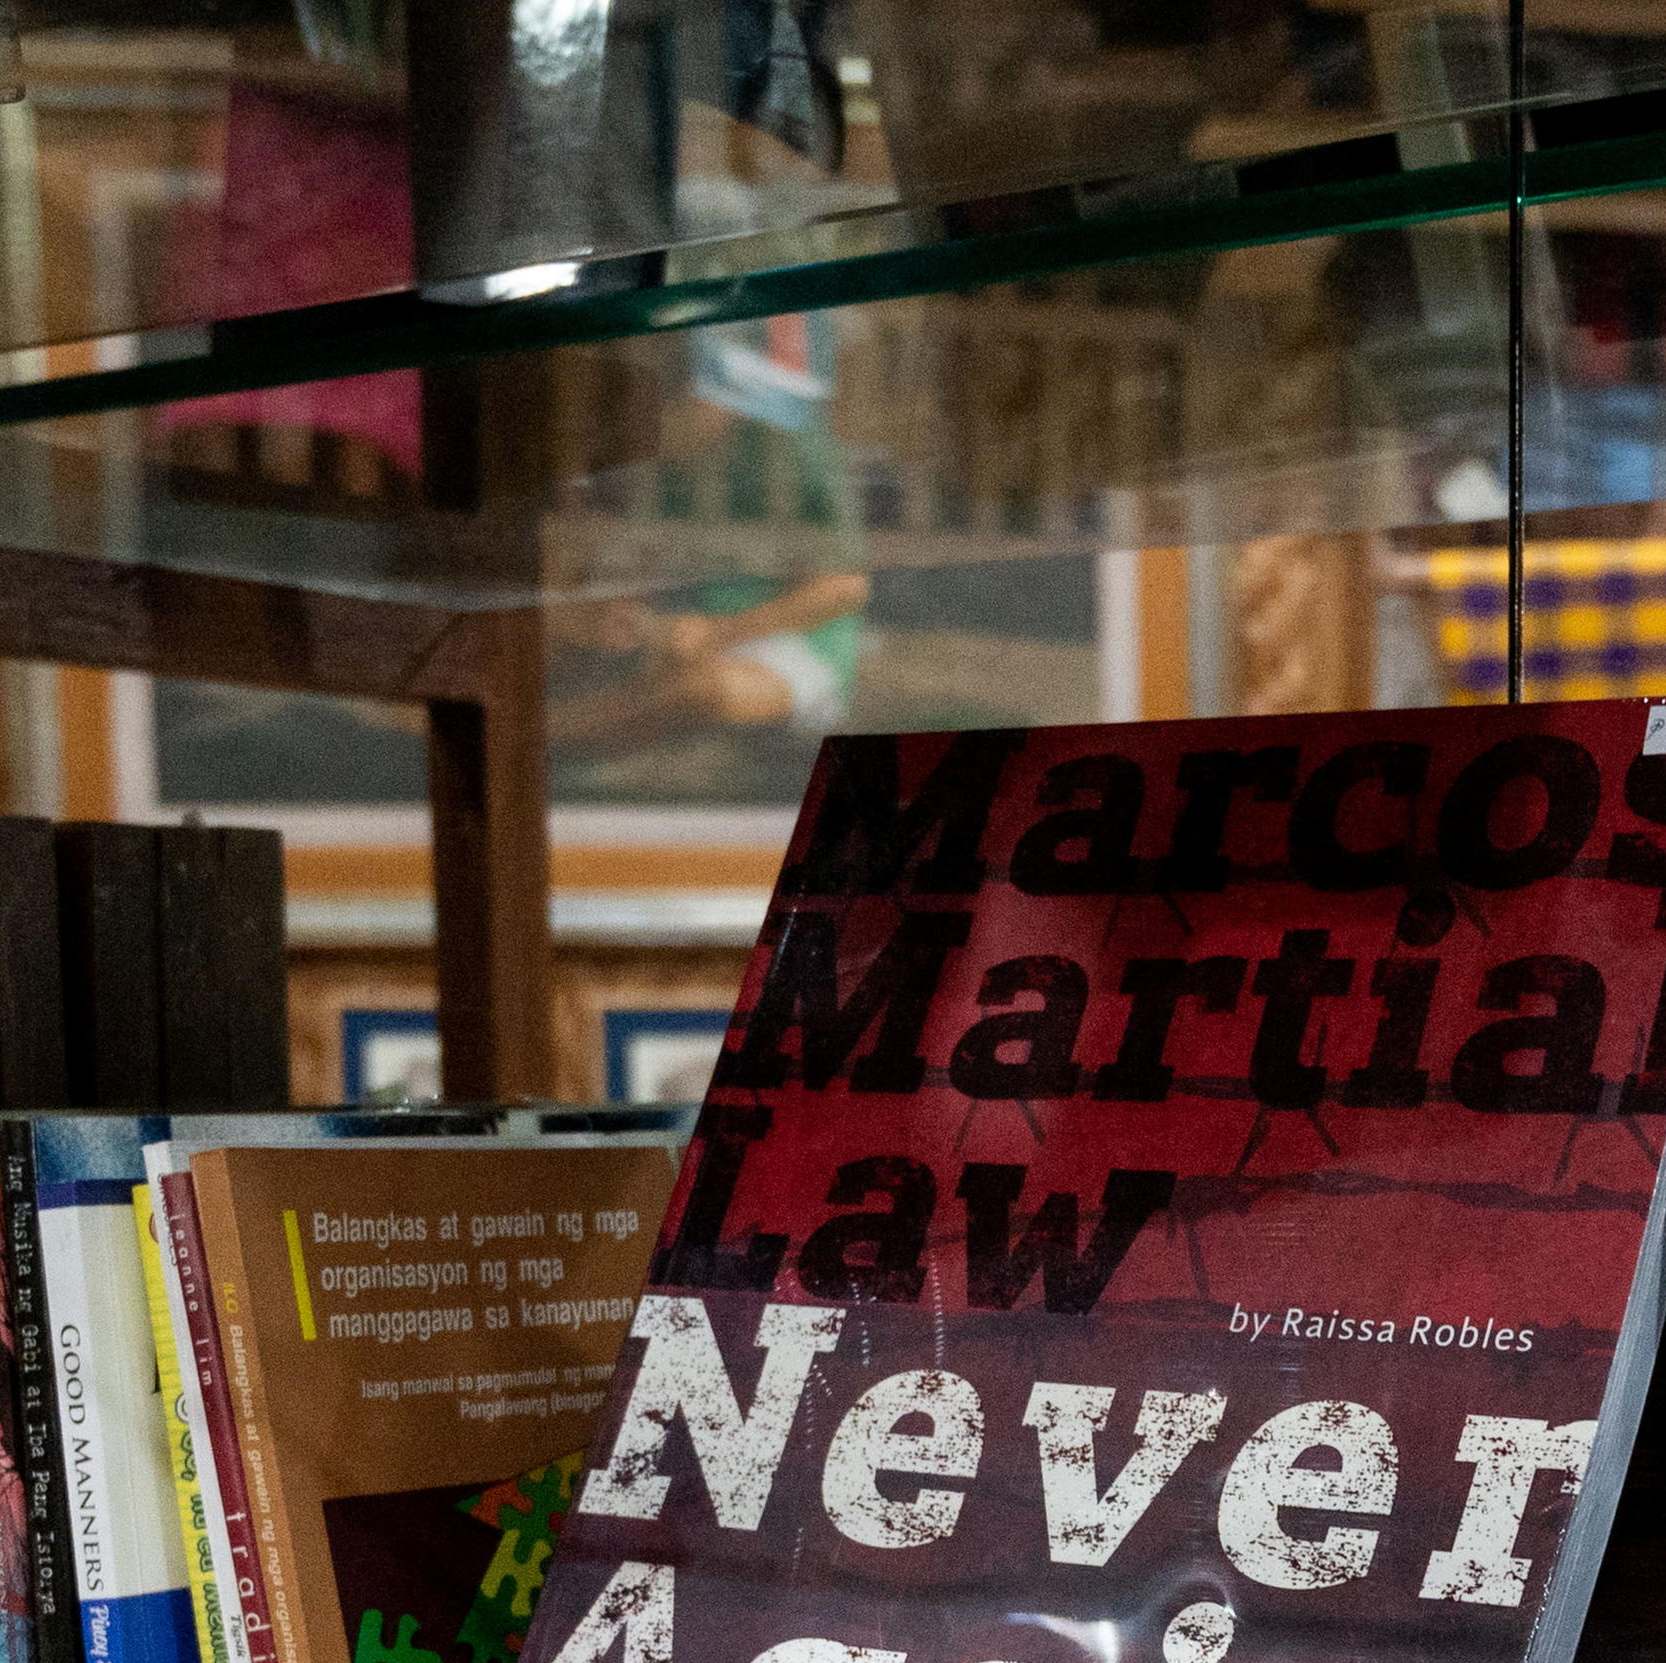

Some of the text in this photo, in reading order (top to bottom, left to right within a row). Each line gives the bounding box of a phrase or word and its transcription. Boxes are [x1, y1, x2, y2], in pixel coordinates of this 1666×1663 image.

[312, 1208, 638, 1249] Balangkas at gawain ng mga
[648, 1106, 1177, 1313] Law
[169, 1212, 215, 1386] jeanne lim
[321, 1257, 564, 1297] organisasyon ng mga
[330, 1297, 633, 1343] manggagawa sa kanayunan
[1229, 1302, 1533, 1351] by Raissa Robles
[58, 1323, 106, 1592] GOOD MANNERS
[578, 1294, 1599, 1607] Never
[86, 1604, 114, 1657] Pinoy
